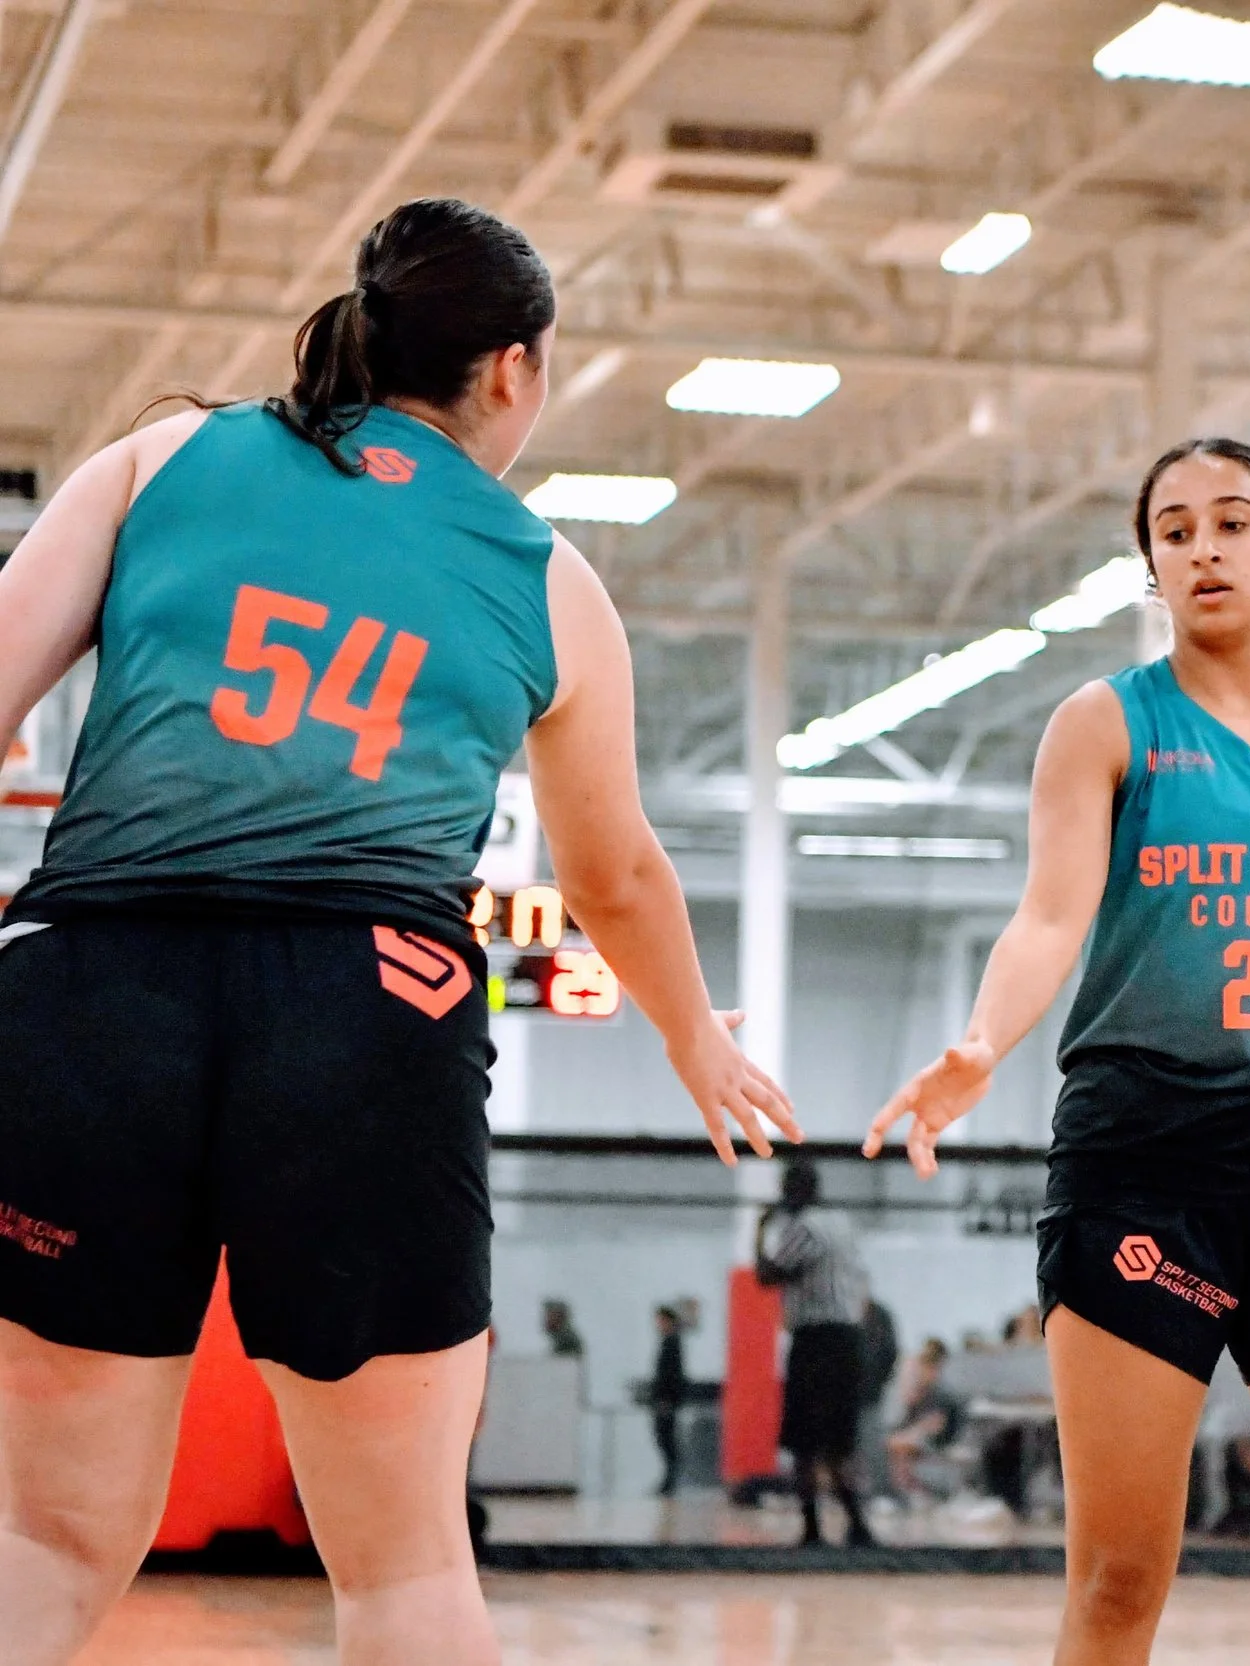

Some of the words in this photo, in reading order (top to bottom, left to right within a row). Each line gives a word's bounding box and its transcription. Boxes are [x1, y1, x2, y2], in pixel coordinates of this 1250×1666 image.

[210, 584, 429, 781] 54
[1139, 844, 1247, 886] SPLIT
[1154, 1272, 1224, 1318] BASKETBALL
[1161, 1261, 1200, 1287] SPLIT
[1196, 1281, 1239, 1310] SECOND
